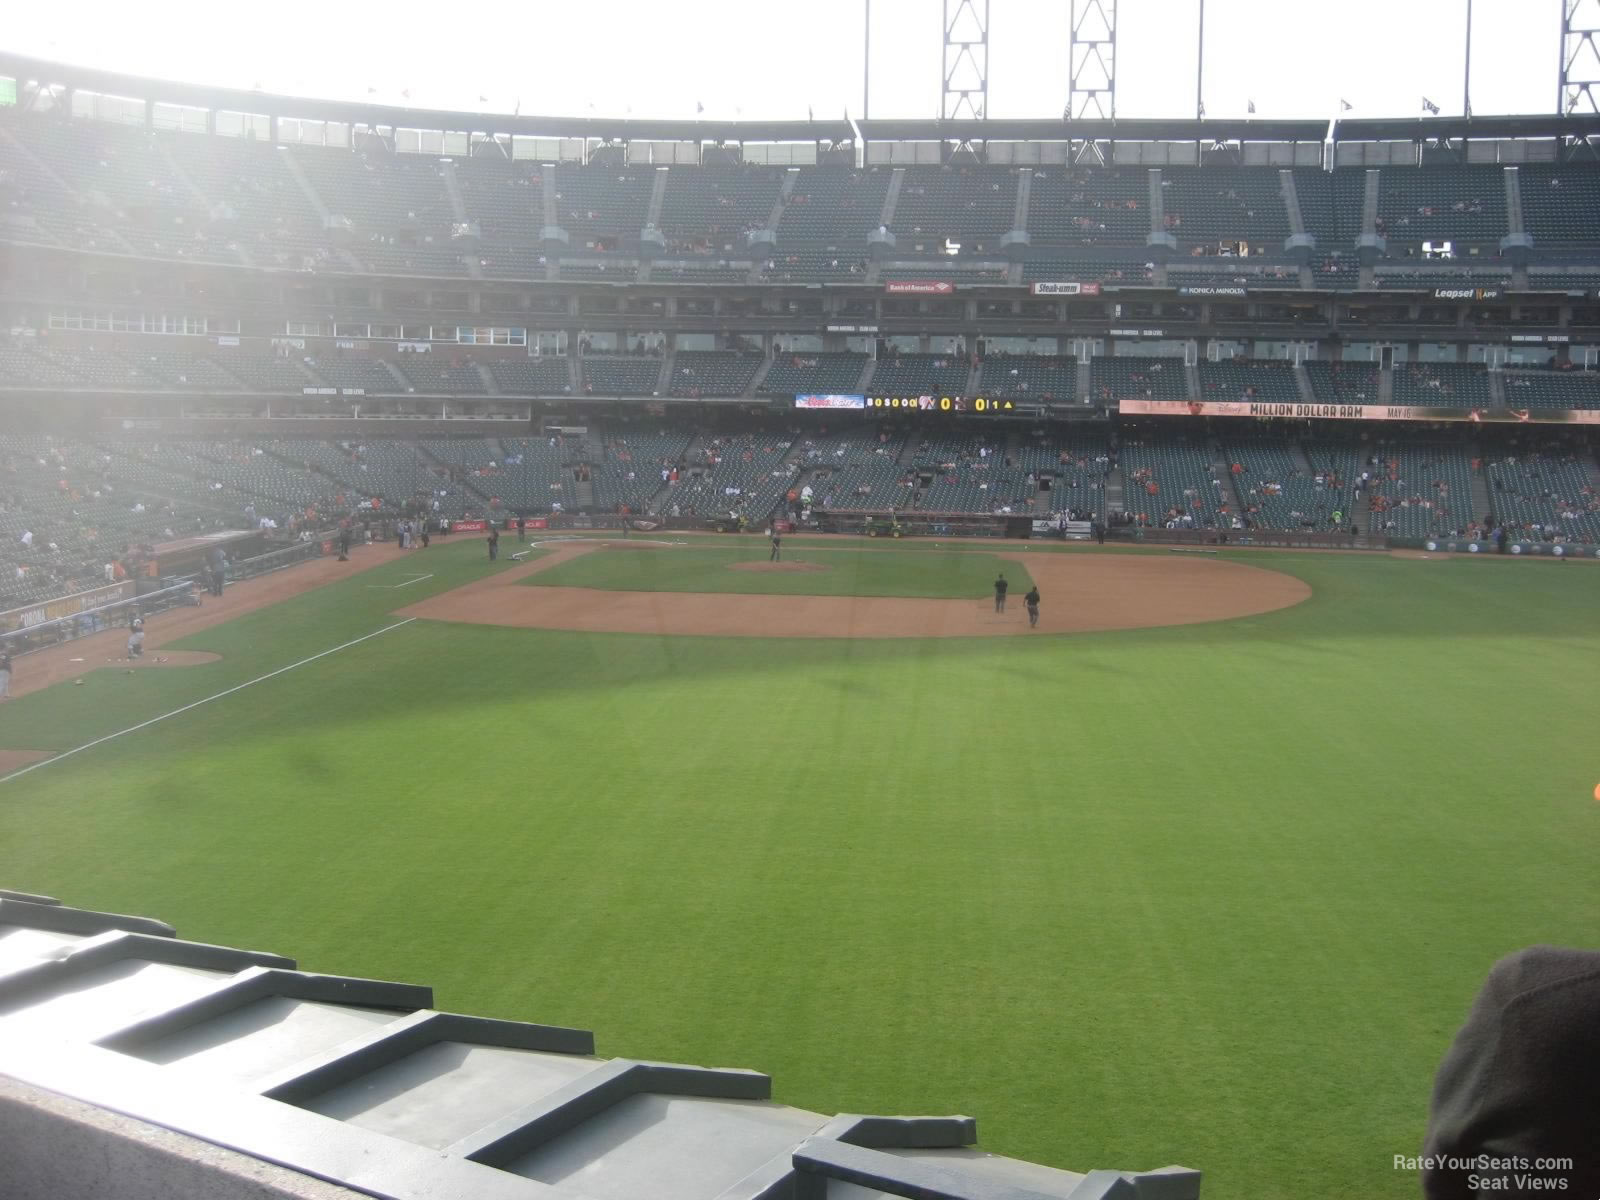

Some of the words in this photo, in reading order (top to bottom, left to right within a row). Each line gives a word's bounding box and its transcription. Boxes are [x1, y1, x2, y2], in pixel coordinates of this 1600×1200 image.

[1435, 289, 1474, 299] Leapset
[940, 397, 951, 411] 0
[975, 398, 986, 412] 0
[1250, 404, 1293, 416] MILLION
[1296, 405, 1336, 417] DOLLAR
[1340, 406, 1363, 418] ARM
[1387, 408, 1401, 418] MAY
